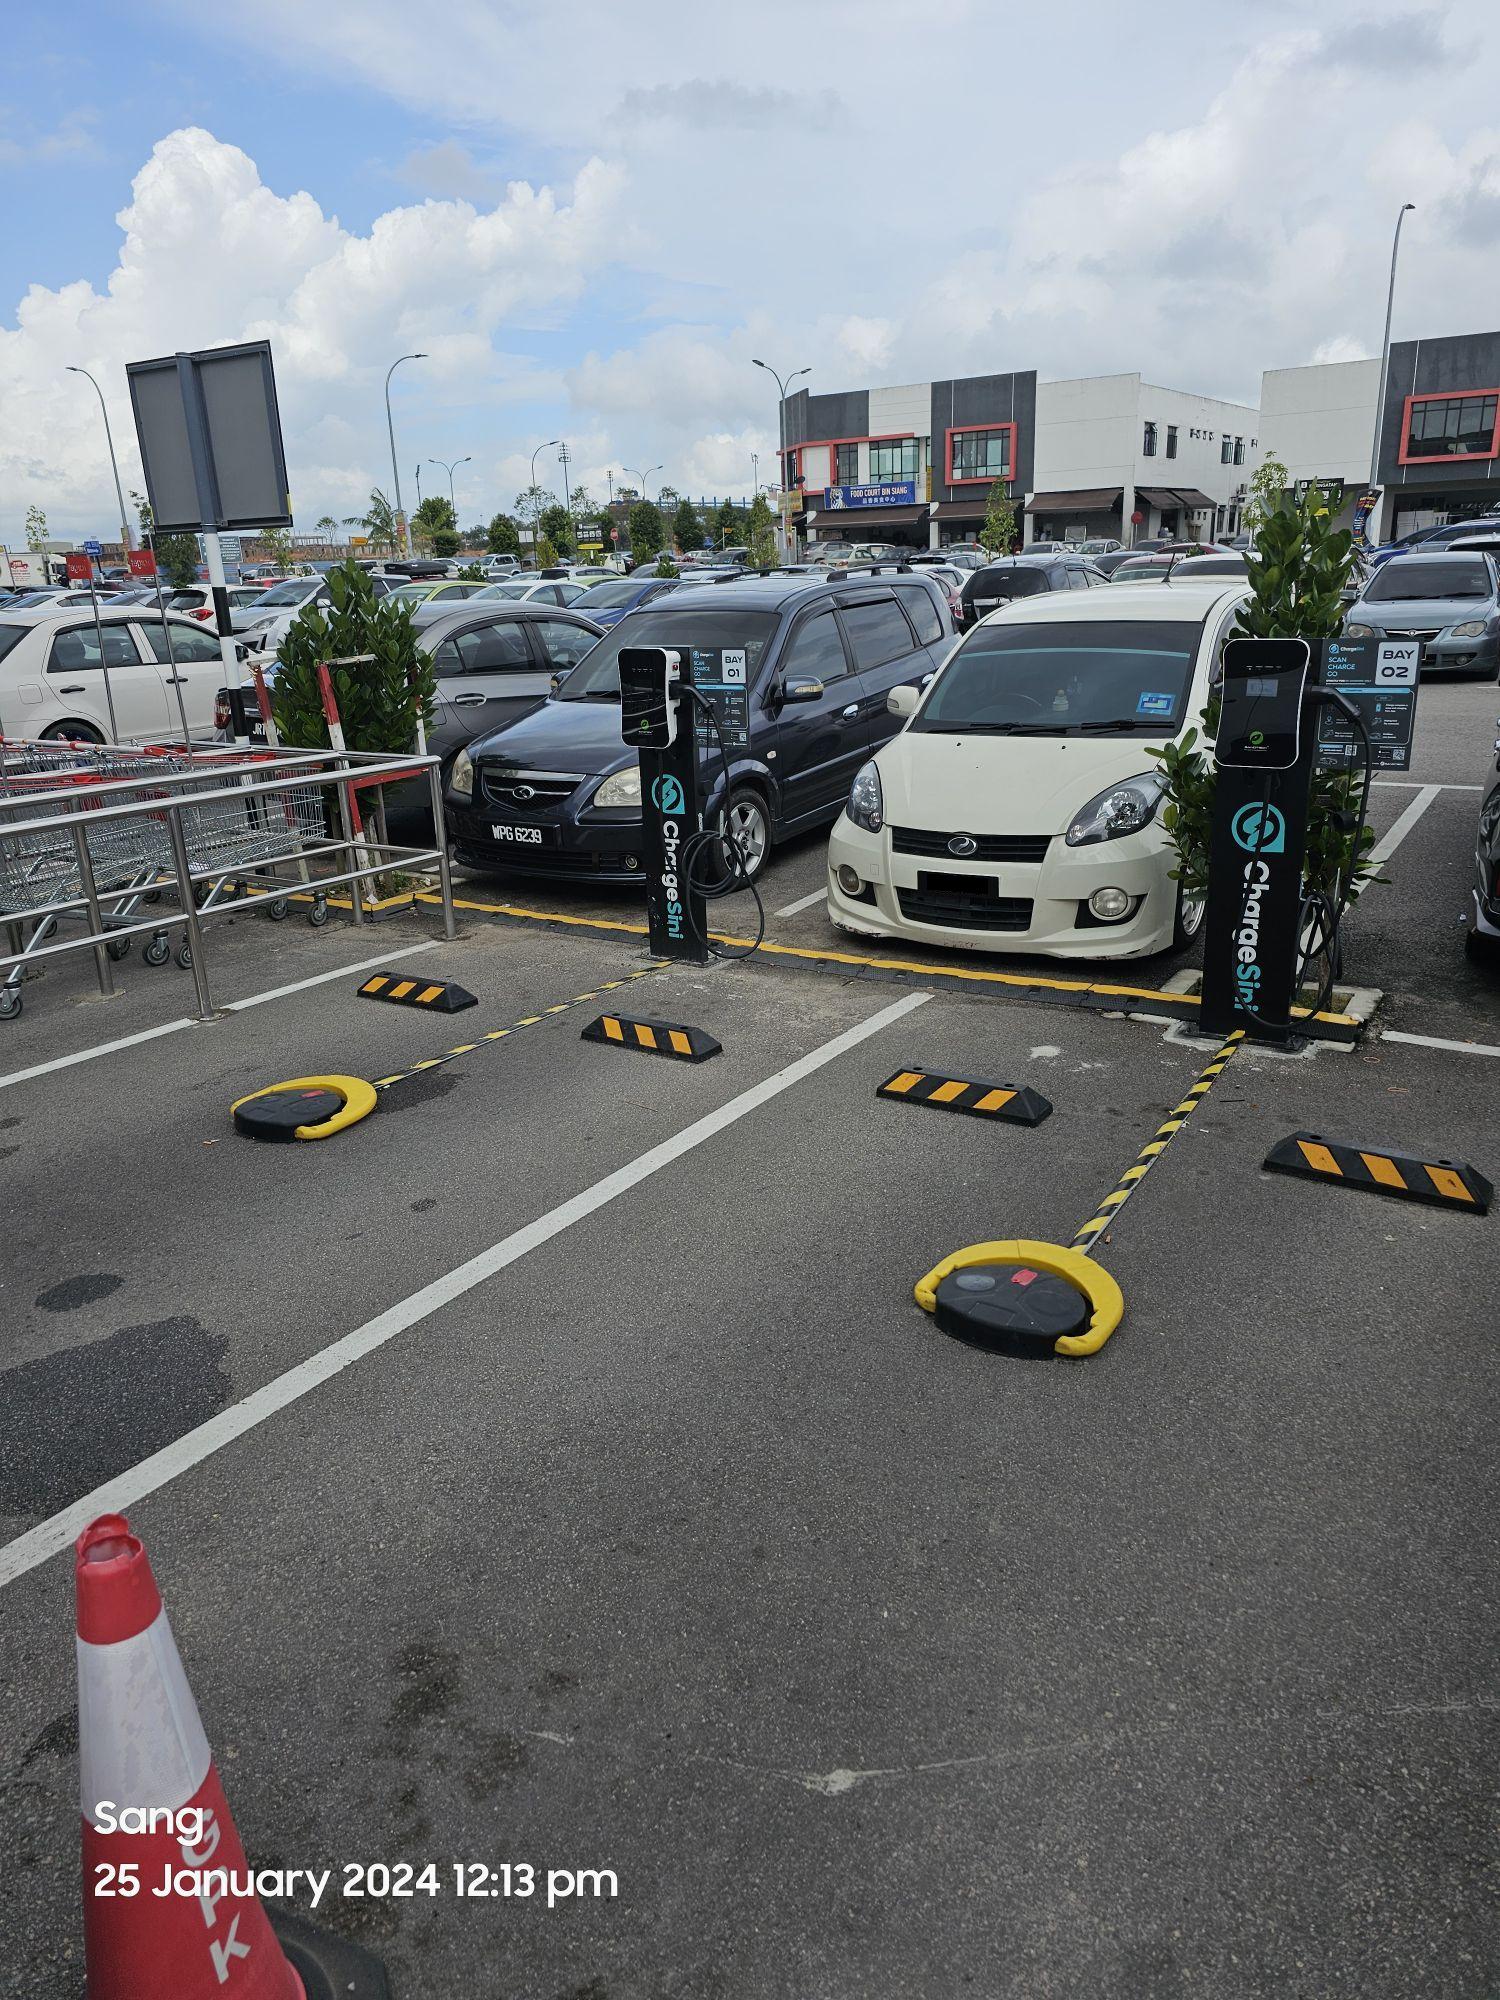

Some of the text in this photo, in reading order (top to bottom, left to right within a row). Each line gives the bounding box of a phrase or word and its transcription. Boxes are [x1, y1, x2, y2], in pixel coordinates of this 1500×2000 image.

[850, 489, 863, 498] FOOD
[864, 488, 880, 497] COURT
[882, 487, 891, 496] BIN
[892, 486, 907, 495] SIANG
[725, 656, 743, 664] BAY
[1383, 650, 1415, 660] BAY
[727, 668, 740, 678] 01
[1381, 666, 1409, 678] 02
[491, 824, 542, 844] WPG 6239
